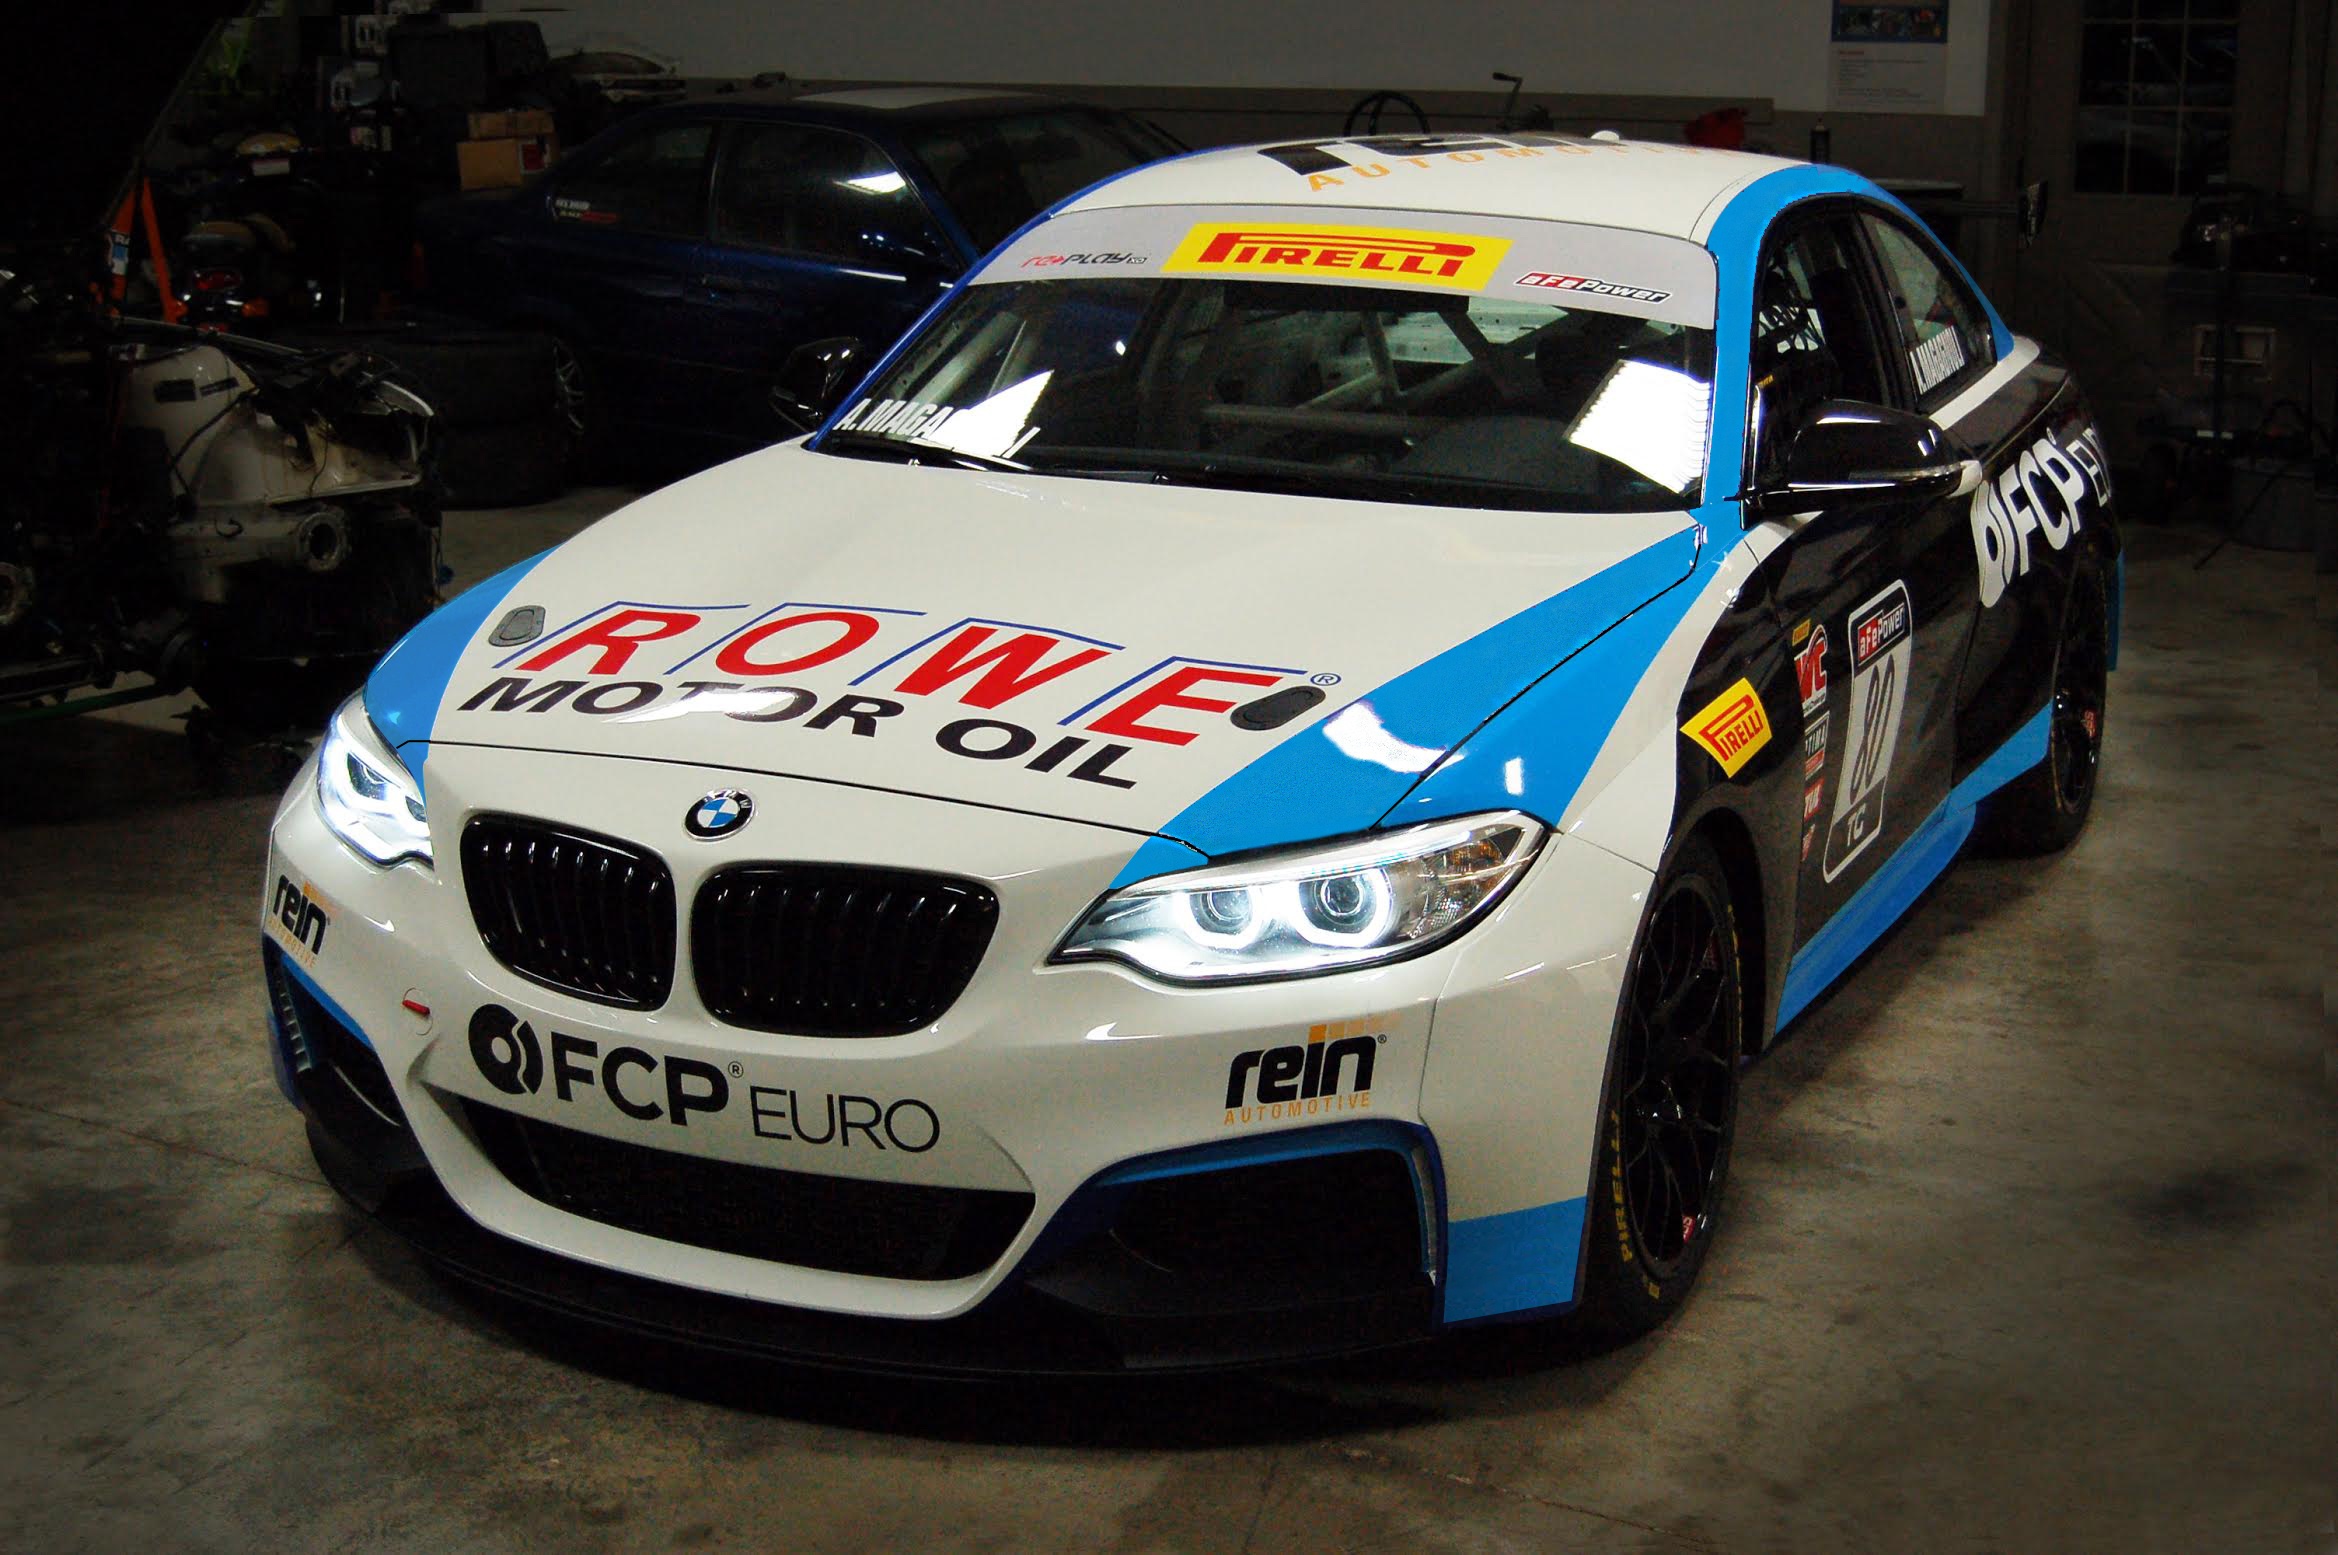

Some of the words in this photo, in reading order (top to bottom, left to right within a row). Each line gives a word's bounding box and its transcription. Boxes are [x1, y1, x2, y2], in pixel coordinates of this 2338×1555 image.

[1197, 232, 1477, 277] PIRELLI
[2000, 438, 2085, 576] FCP
[515, 608, 1285, 747] ROWE
[456, 677, 905, 738] MOTOR
[935, 717, 1138, 790] OIL
[1699, 694, 1764, 762] PIRELLI
[1850, 653, 1895, 804] 80
[1846, 803, 1867, 847] TC
[273, 874, 327, 955] rein
[551, 1031, 730, 1127] FCP
[750, 1085, 941, 1154] EURO
[1224, 1091, 1372, 1126] AUTOMOTIVE
[1225, 1024, 1377, 1110] rein
